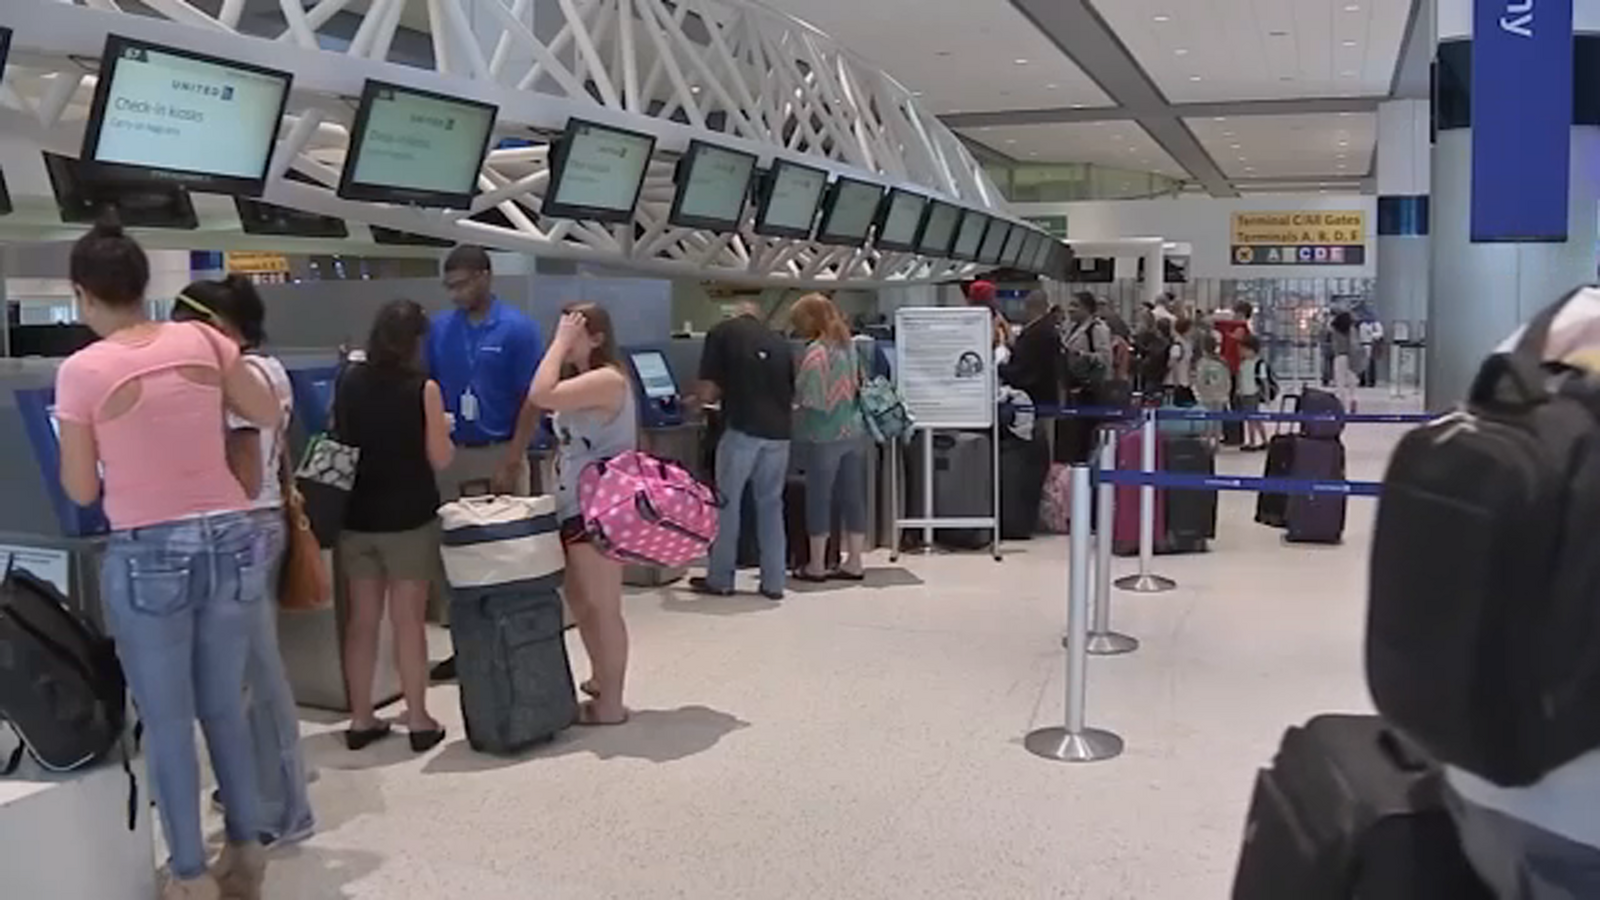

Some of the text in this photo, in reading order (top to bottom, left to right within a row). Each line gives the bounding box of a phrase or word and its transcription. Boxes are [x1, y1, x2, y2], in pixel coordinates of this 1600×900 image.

[172, 79, 219, 96] UNITED
[115, 97, 166, 118] Check-in
[1238, 214, 1290, 226] Terminal
[1324, 214, 1360, 226] Gates
[1237, 230, 1298, 242] Terminals
[1267, 248, 1282, 260] A
[1299, 247, 1311, 260] C
[1315, 247, 1327, 260] D
